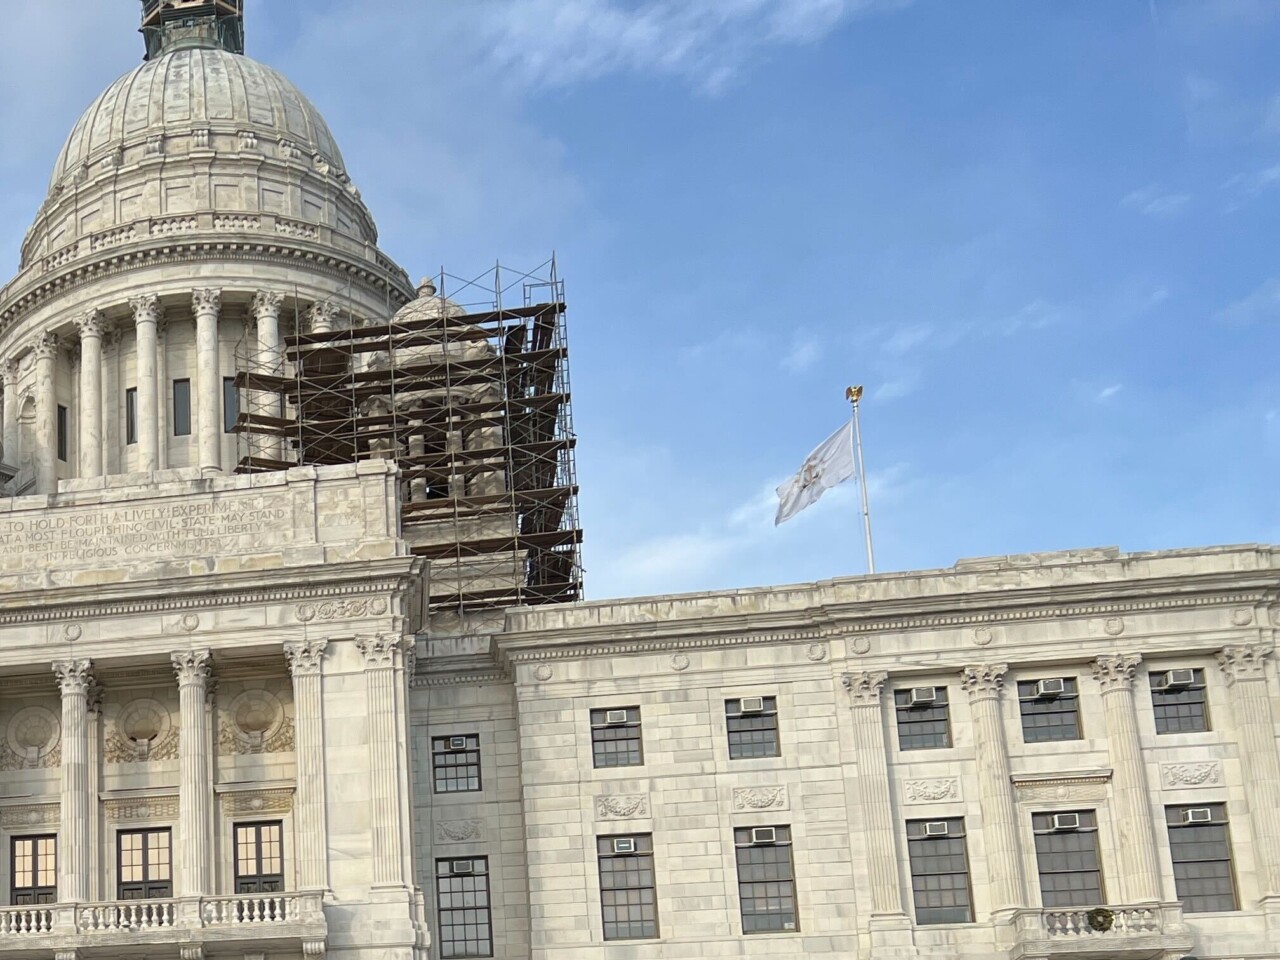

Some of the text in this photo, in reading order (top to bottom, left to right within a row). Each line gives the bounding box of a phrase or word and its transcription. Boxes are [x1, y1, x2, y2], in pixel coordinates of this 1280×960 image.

[7, 498, 258, 533] TO HOLD FORTH A LIVELY EXPERIMENT
[14, 534, 22, 543] A
[25, 530, 56, 542] MOST
[61, 523, 143, 539] FLOURISHING
[146, 518, 176, 531] CIVIL
[181, 515, 215, 527] STATE
[220, 513, 246, 522] MAY
[248, 509, 285, 521] STAND
[3, 544, 24, 554] AND
[28, 541, 56, 551] BEST
[60, 540, 73, 550] BE
[78, 533, 148, 548] MAINTAINED
[150, 529, 180, 541] WITH
[217, 522, 263, 535] LIBERTY
[45, 552, 57, 562] IN
[62, 548, 118, 560] RELIGIOUS
